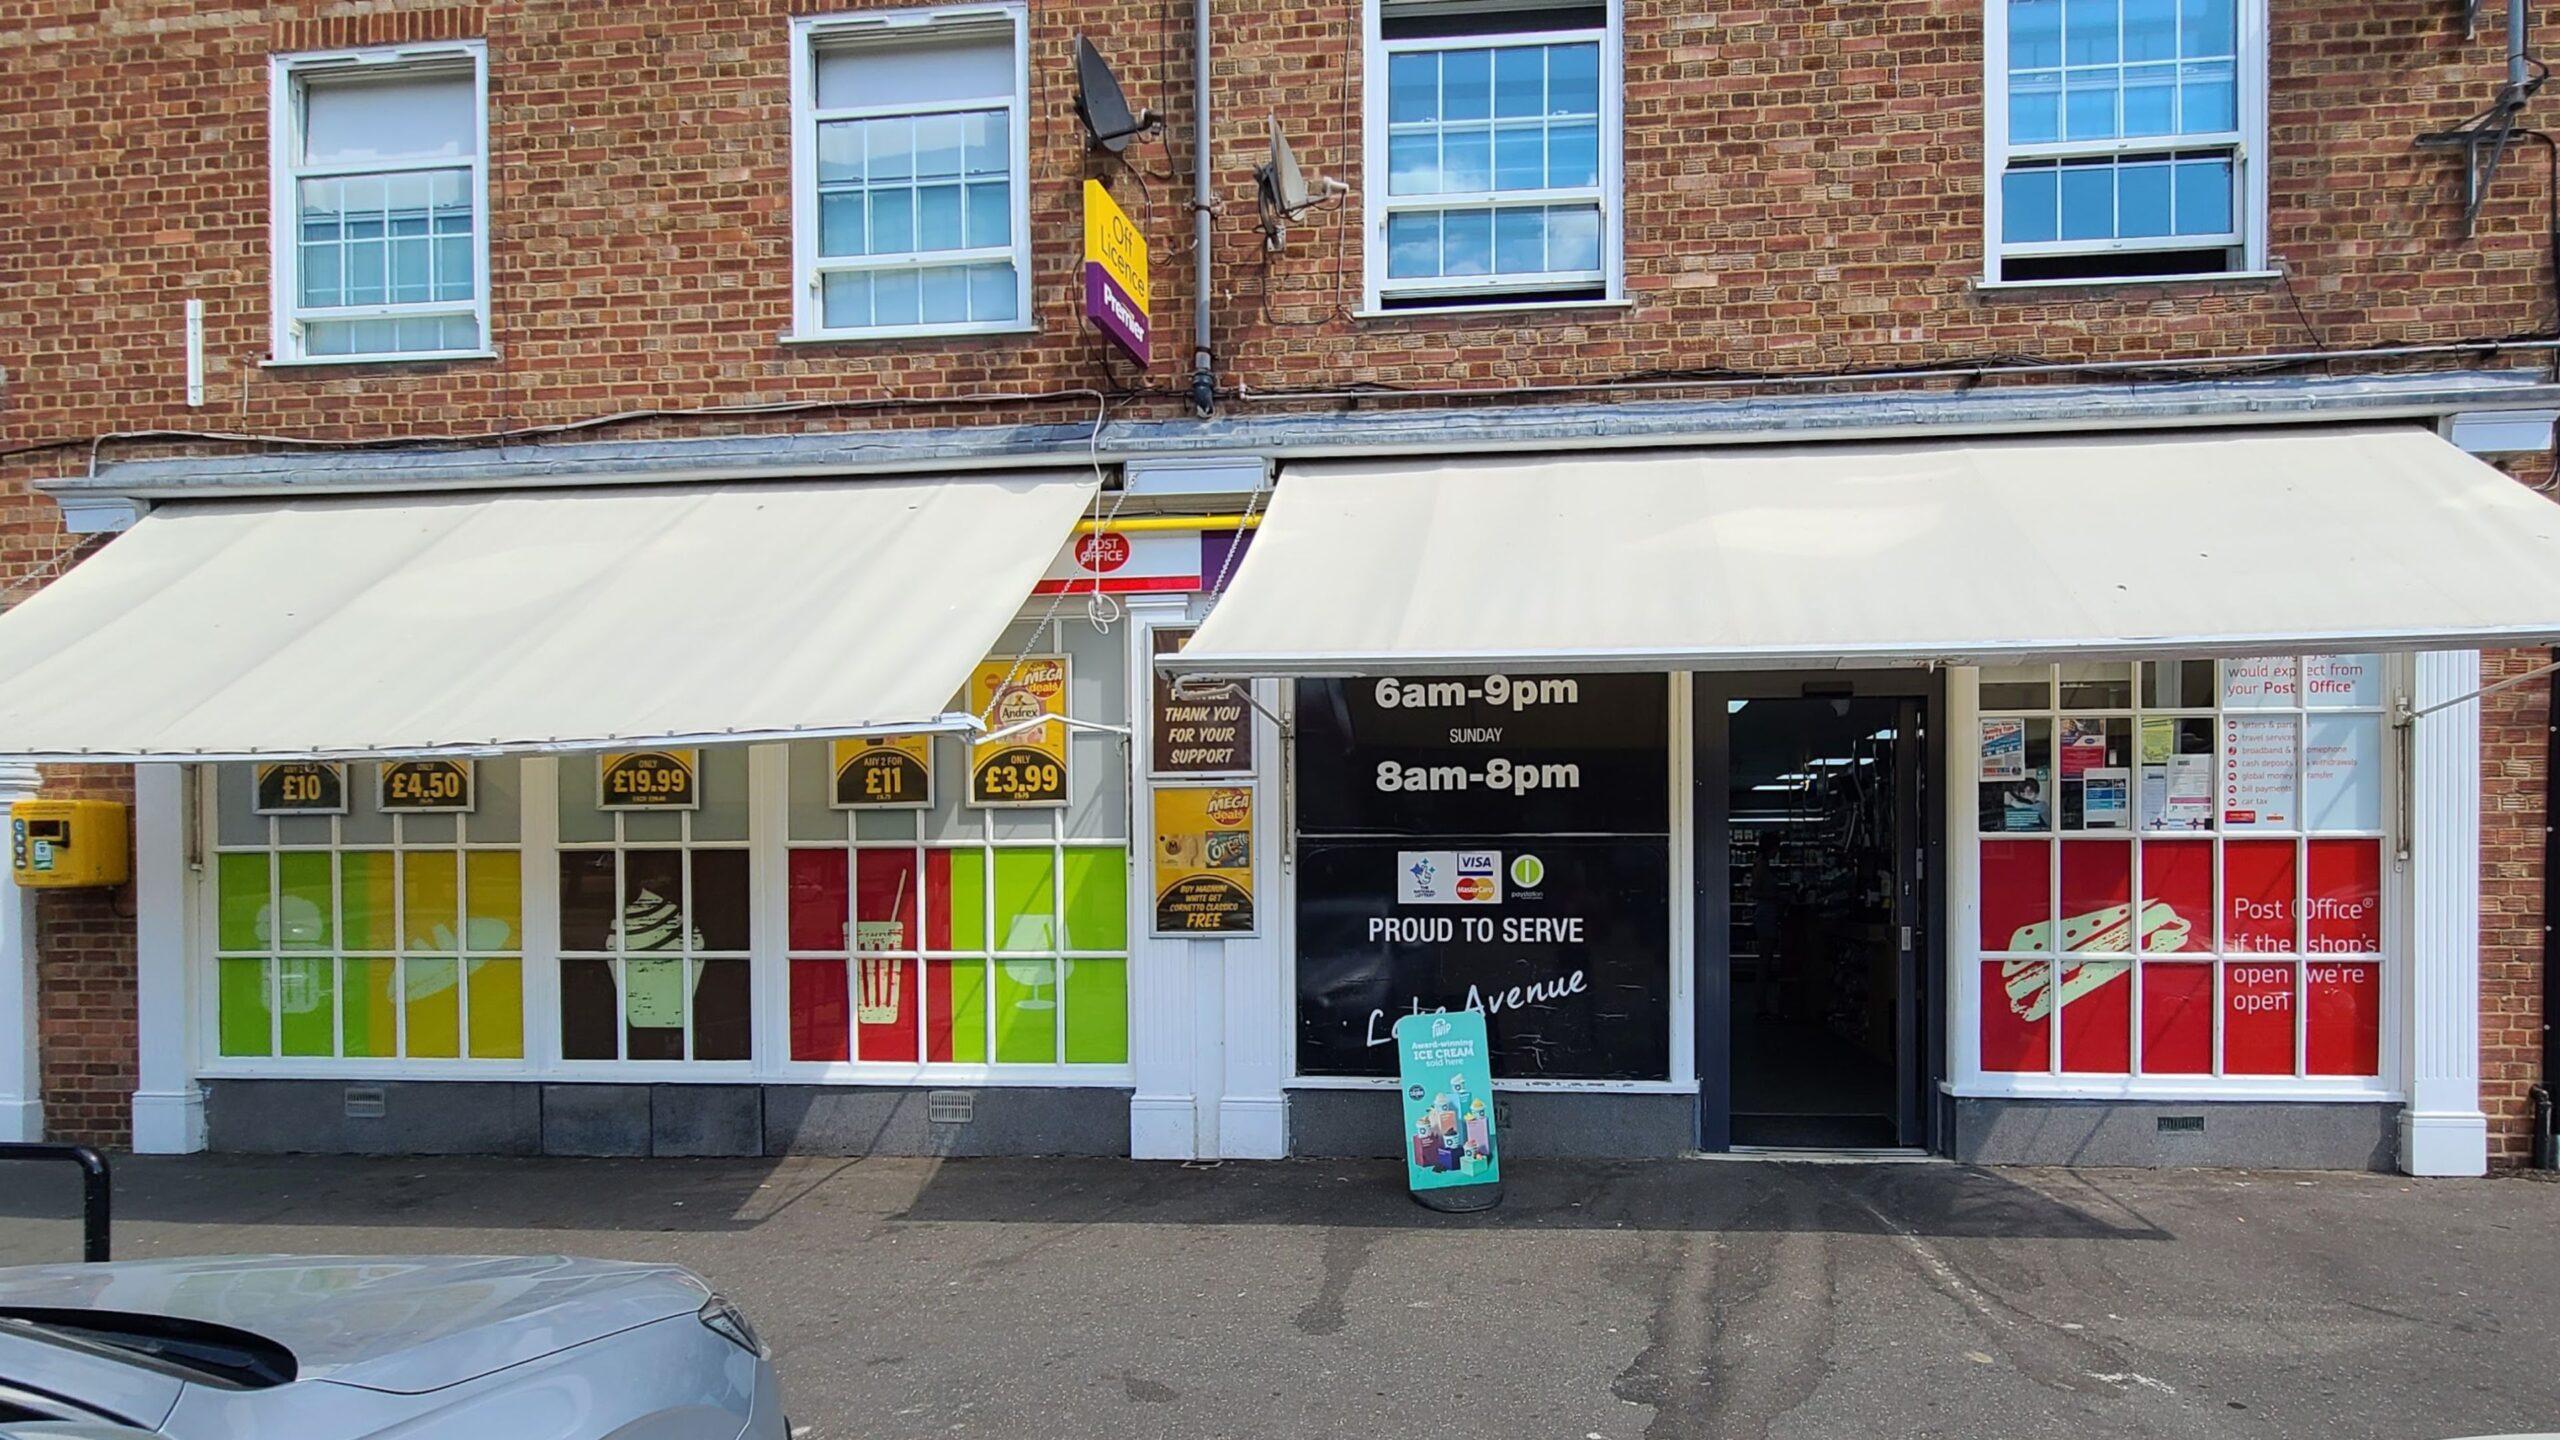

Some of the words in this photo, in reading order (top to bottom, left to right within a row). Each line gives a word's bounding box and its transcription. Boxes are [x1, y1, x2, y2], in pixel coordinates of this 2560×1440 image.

[1112, 216, 1133, 257] Off
[1100, 224, 1145, 298] Licence
[1103, 282, 1145, 343] Premier
[1088, 539, 1119, 550] POST
[1081, 550, 1123, 562] OFFICE
[1023, 667, 1063, 685] MEGA
[2228, 665, 2268, 678] would
[2330, 663, 2363, 677] from
[1029, 682, 1058, 692] deals
[1375, 674, 1578, 711] 6am-9pm
[2227, 684, 2259, 698] your
[2264, 681, 2296, 694] Post
[1002, 707, 1037, 719] Andrex
[1165, 707, 1210, 722] THANK
[1213, 706, 1241, 721] YOU
[1168, 728, 1195, 743] FOR
[1199, 727, 1236, 742] YOUR
[1449, 727, 1503, 744] SUNDAY
[864, 758, 879, 766] ANY
[887, 757, 903, 766] FOR
[1010, 755, 1031, 764] ONLY
[1170, 748, 1234, 764] SUPPORT
[392, 773, 459, 798] £4.50
[613, 769, 685, 793] £19.99
[866, 767, 901, 793] £11
[985, 764, 1058, 793] £3.99
[1376, 758, 1580, 796] 8am-8pm
[283, 775, 321, 800] £10
[1207, 795, 1250, 813] MEGA
[1213, 810, 1244, 819] deals
[1461, 857, 1492, 868] VISA
[2234, 898, 2283, 919] Post
[1186, 912, 1222, 928] FREE
[1369, 917, 1453, 943] PROUD
[1461, 917, 1494, 943] TO
[1502, 917, 1584, 943] SERVE
[2234, 932, 2249, 952] if
[2255, 934, 2291, 953] the
[2308, 933, 2377, 953] shop's
[2234, 967, 2288, 988] open
[2306, 964, 2364, 984] we're
[1464, 970, 1588, 1018] Avenue
[2233, 994, 2288, 1015] open
[1411, 1040, 1474, 1050] Award-winning
[1413, 1050, 1433, 1061] ICE
[1435, 1047, 1475, 1059] CREAM
[1426, 1059, 1444, 1067] sold
[1445, 1057, 1464, 1066] here
